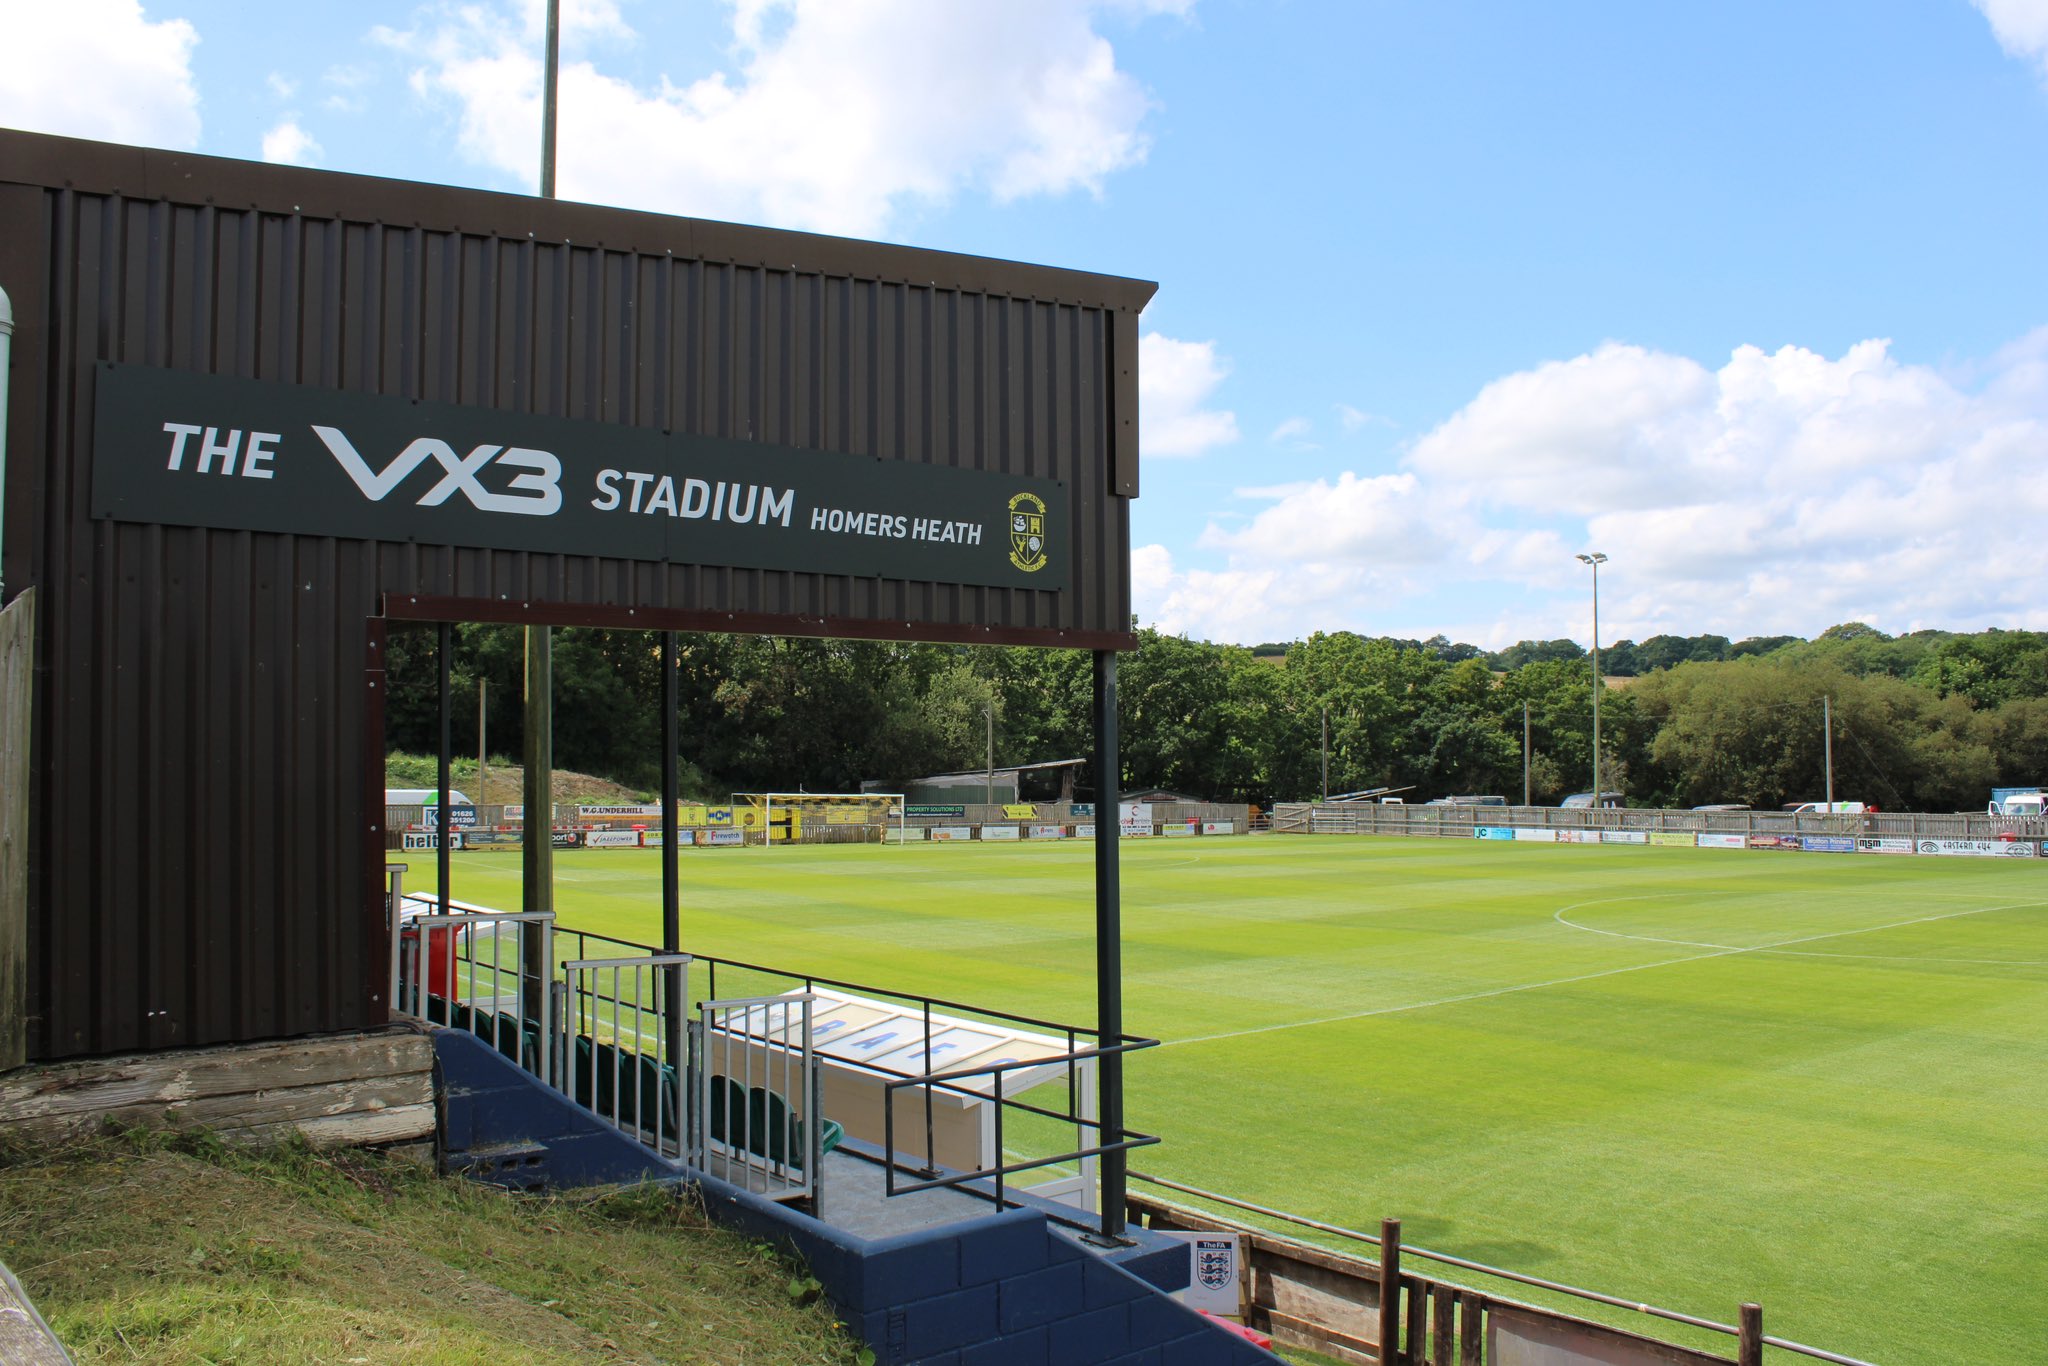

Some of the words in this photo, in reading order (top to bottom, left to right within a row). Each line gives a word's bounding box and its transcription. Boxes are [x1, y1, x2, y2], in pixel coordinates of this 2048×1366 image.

[163, 421, 282, 480] THE
[310, 424, 563, 517] VX3
[590, 467, 796, 529] STADIUM
[809, 506, 908, 540] HOMERS
[911, 517, 983, 546] HEATH
[1943, 841, 1974, 851] EASTERN
[1977, 842, 1991, 852] EYE
